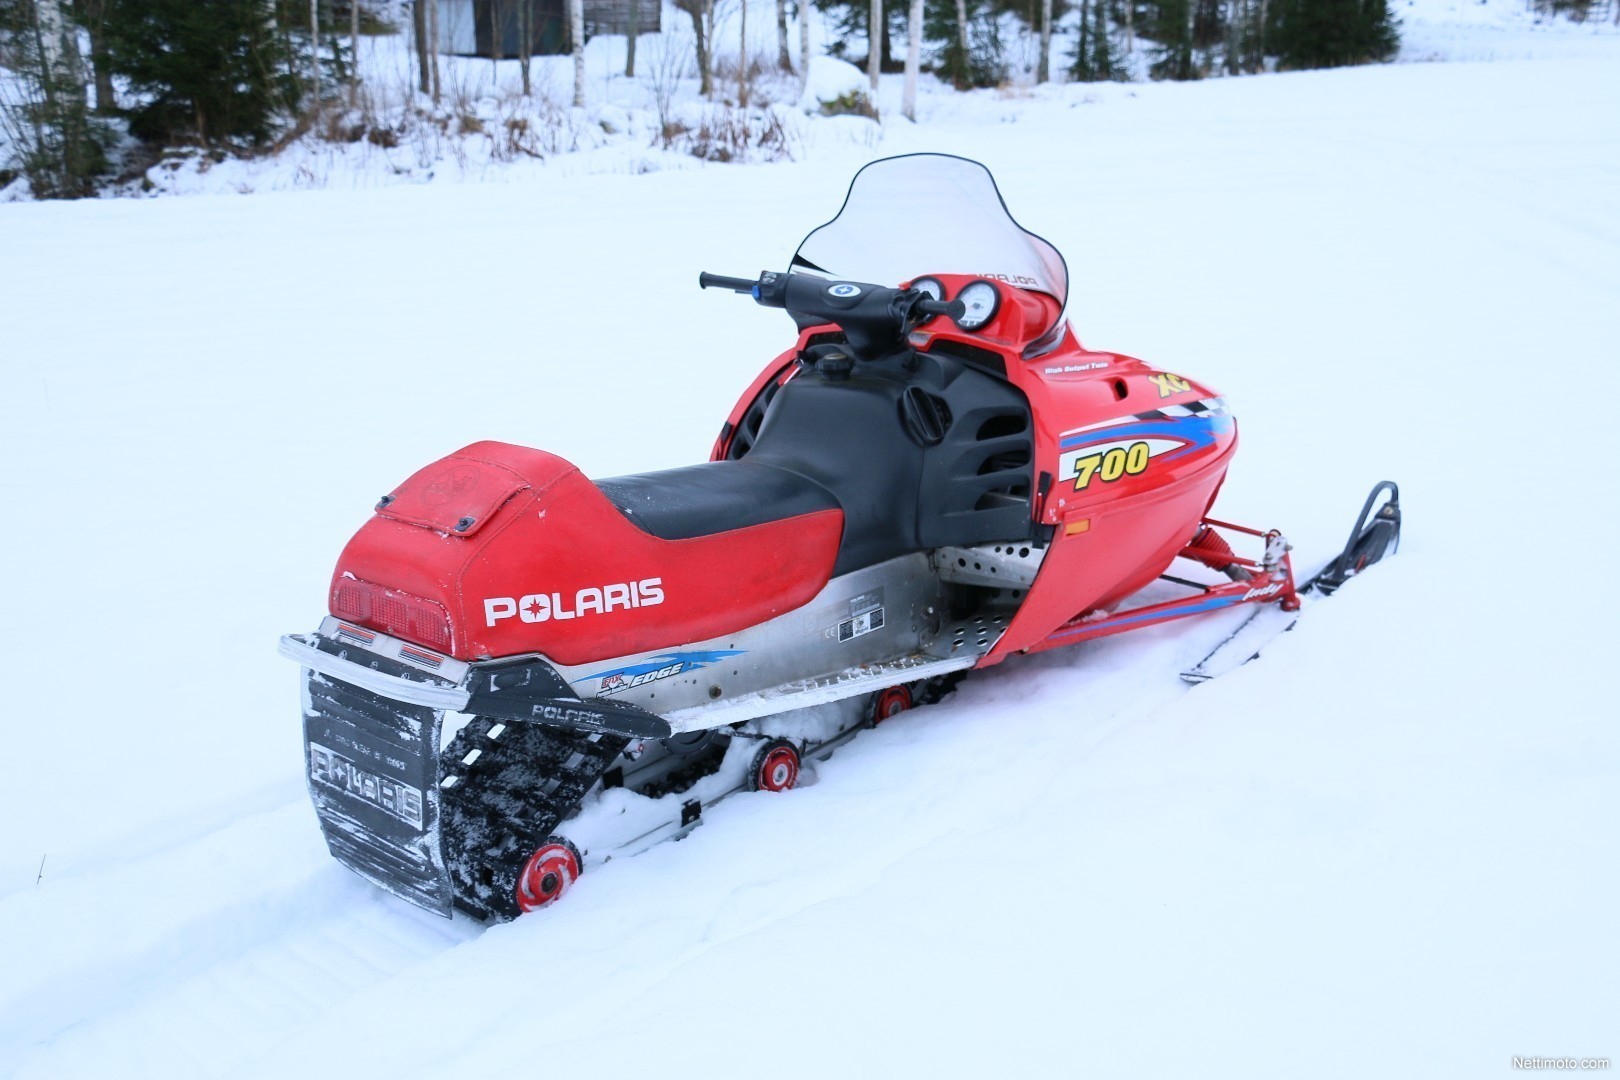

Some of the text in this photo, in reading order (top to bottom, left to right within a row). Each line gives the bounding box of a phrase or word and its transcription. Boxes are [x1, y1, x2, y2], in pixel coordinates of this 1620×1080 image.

[1045, 361, 1109, 375] High Output Twin
[1147, 373, 1191, 399] XC
[1073, 441, 1150, 492] 700
[484, 577, 665, 627] POLARIS
[628, 661, 685, 689] EDGE
[532, 704, 606, 724] POLARIS
[311, 747, 422, 827] POLARIS
